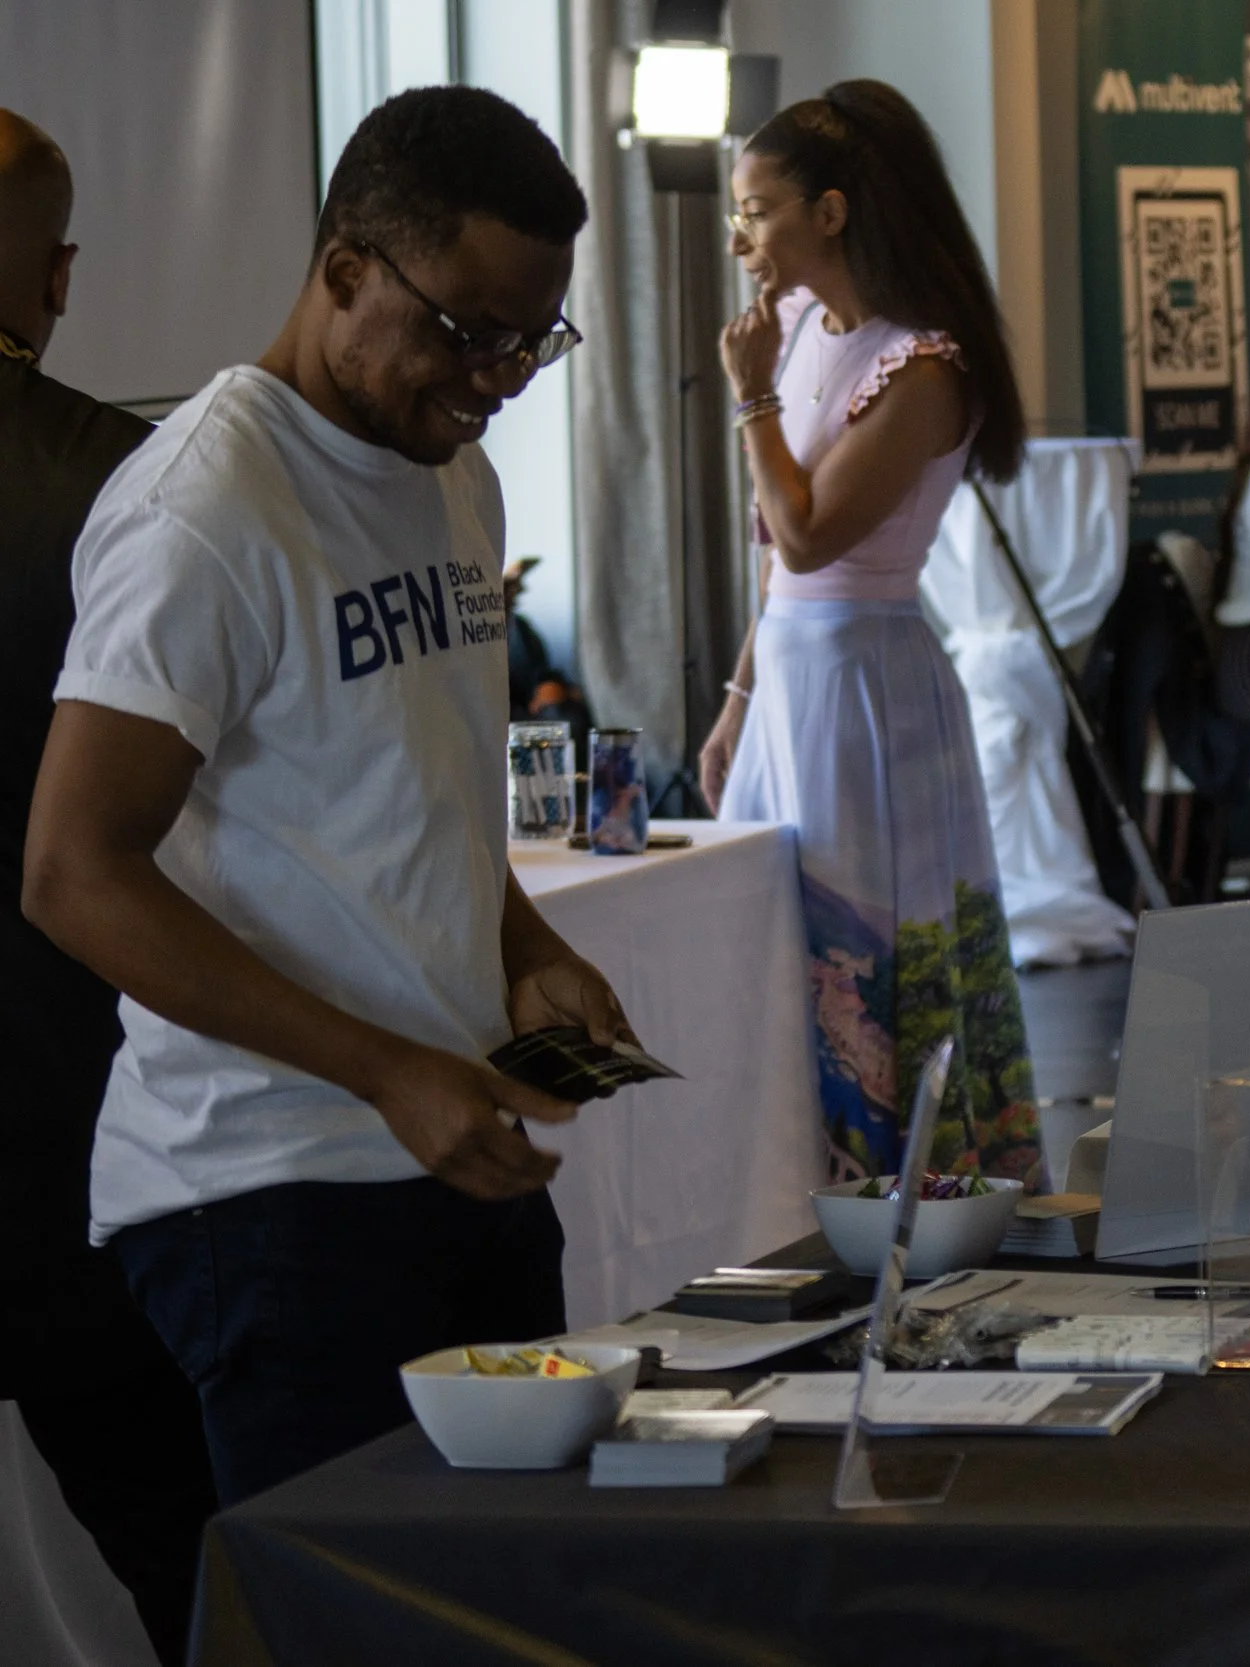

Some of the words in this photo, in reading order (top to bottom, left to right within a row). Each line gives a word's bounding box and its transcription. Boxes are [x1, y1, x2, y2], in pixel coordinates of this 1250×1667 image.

[447, 560, 487, 587] Black
[454, 587, 506, 616] Founde
[334, 565, 450, 681] BFN
